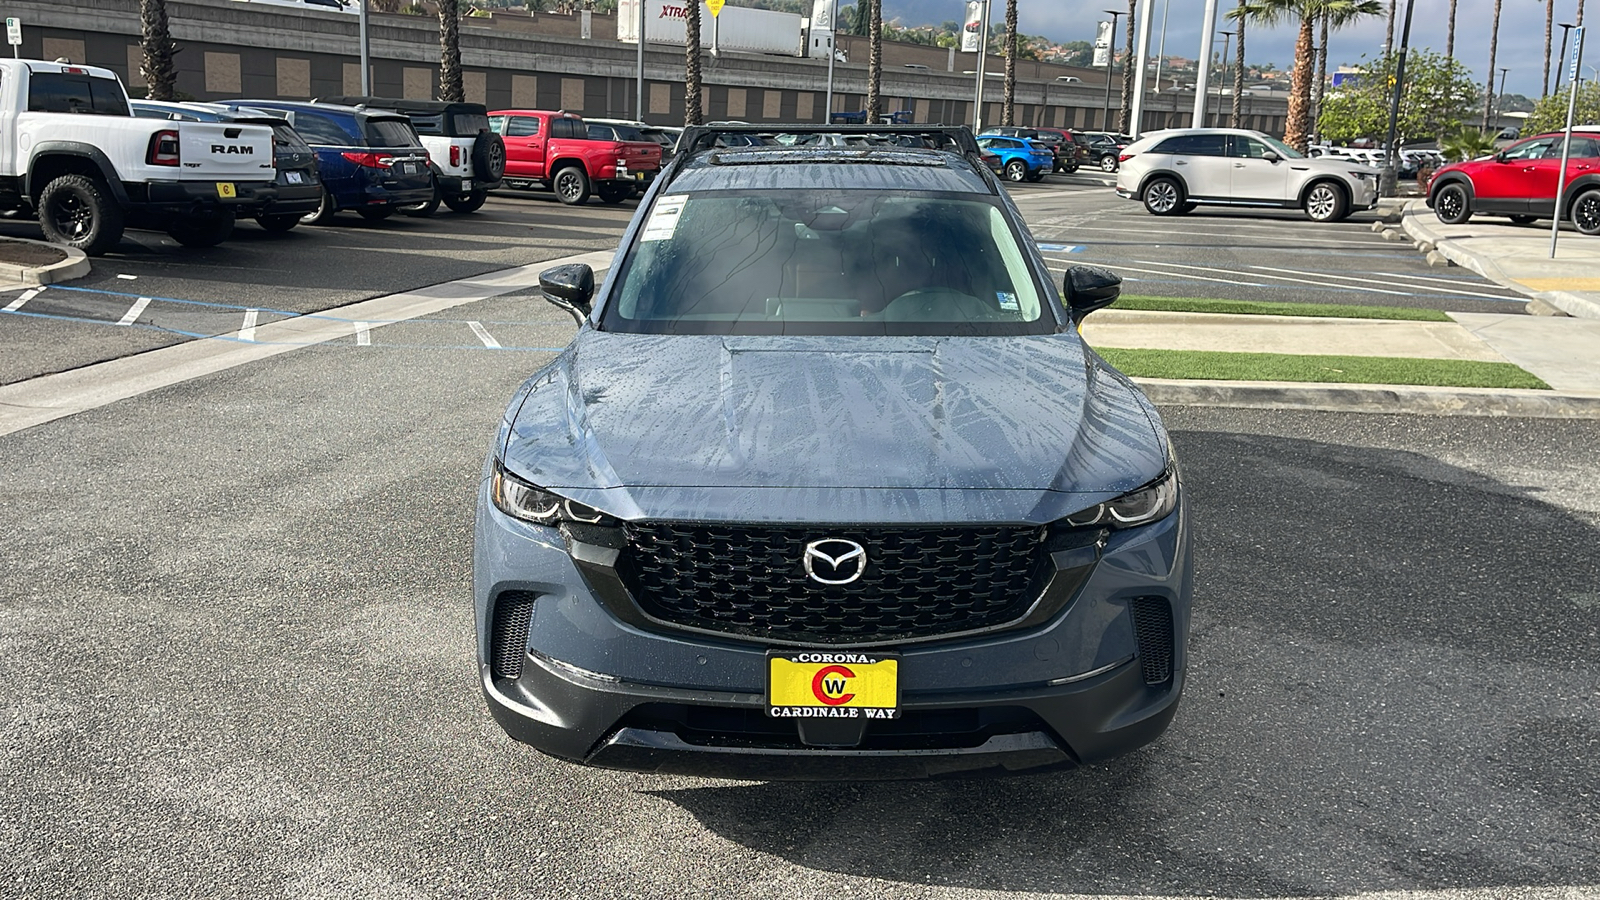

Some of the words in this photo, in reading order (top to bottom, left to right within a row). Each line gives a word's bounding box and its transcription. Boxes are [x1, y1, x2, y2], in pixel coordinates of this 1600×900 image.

[659, 5, 688, 18] XTRA
[211, 145, 253, 154] RAM
[799, 653, 869, 663] CORONA
[771, 707, 859, 718] CARDINALE
[864, 708, 896, 719] WAY
